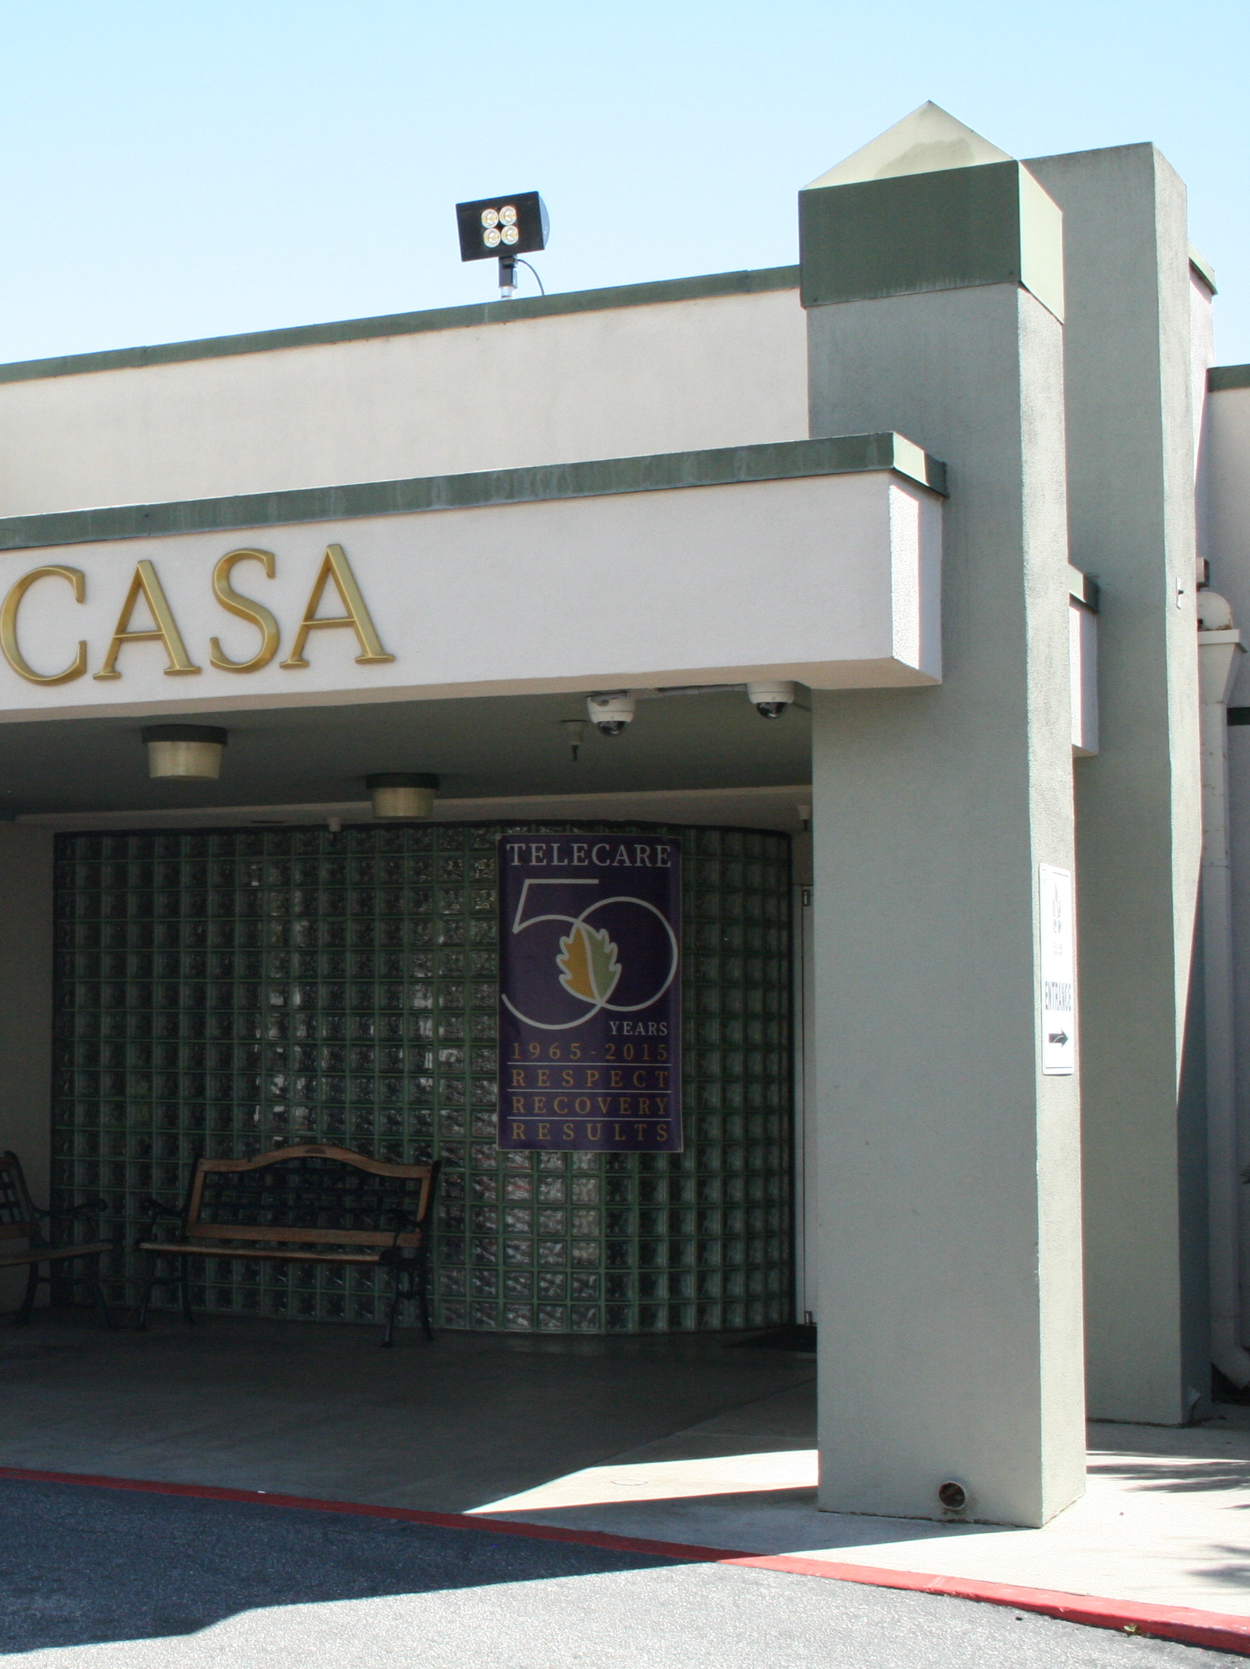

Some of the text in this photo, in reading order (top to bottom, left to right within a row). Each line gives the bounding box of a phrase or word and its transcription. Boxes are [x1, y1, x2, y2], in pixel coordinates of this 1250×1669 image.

[506, 843, 671, 867] TELECARE
[501, 878, 678, 1029] 50
[609, 1021, 668, 1036] YEARS
[512, 1043, 668, 1060] 1965-2015
[512, 1070, 669, 1088] RESPECT
[512, 1097, 668, 1115] RECOVERY
[512, 1123, 668, 1141] RESULTS
